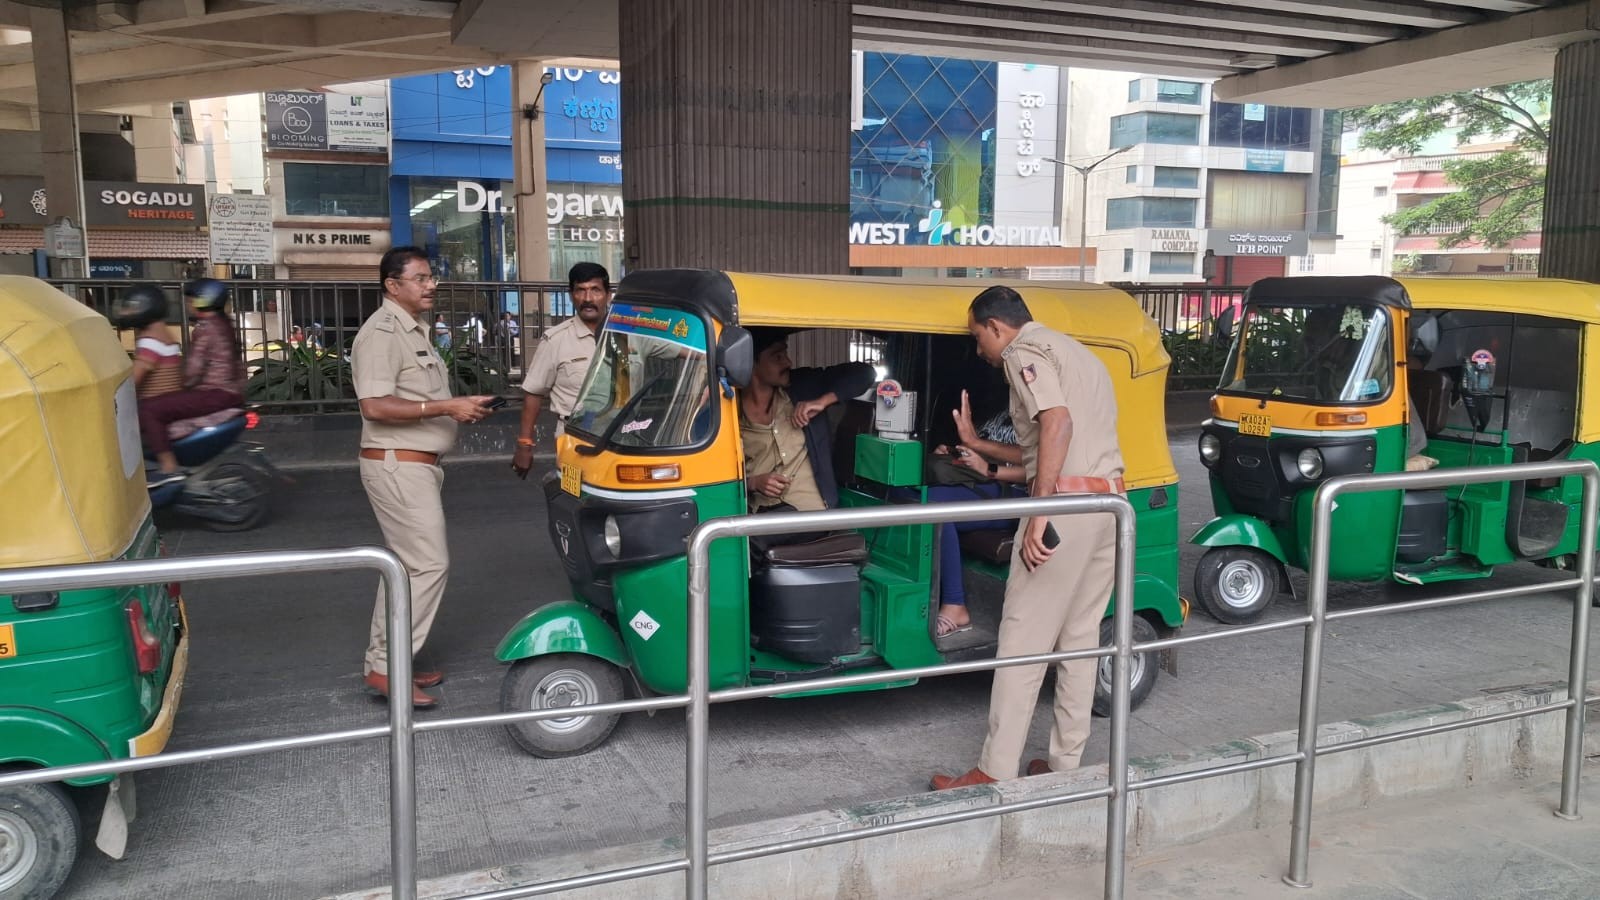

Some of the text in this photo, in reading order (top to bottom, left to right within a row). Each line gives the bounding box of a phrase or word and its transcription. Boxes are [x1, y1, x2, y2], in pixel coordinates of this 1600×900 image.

[563, 96, 617, 132] ಕಣ್ಣಿನ
[329, 119, 354, 127] LOANS
[363, 120, 385, 128] TAXES
[271, 133, 325, 143] BLOOMING
[599, 155, 623, 169] ಡಾಕ್ಟ
[100, 189, 193, 207] SOGADU
[457, 181, 507, 213] Dr.
[127, 208, 196, 220] HERITAGE
[331, 234, 371, 245] PRIME
[959, 225, 1064, 246] HOSPITAL
[1151, 229, 1191, 241] RAMANNA
[1236, 244, 1284, 254] IFB POINT
[634, 621, 653, 630] CNG
